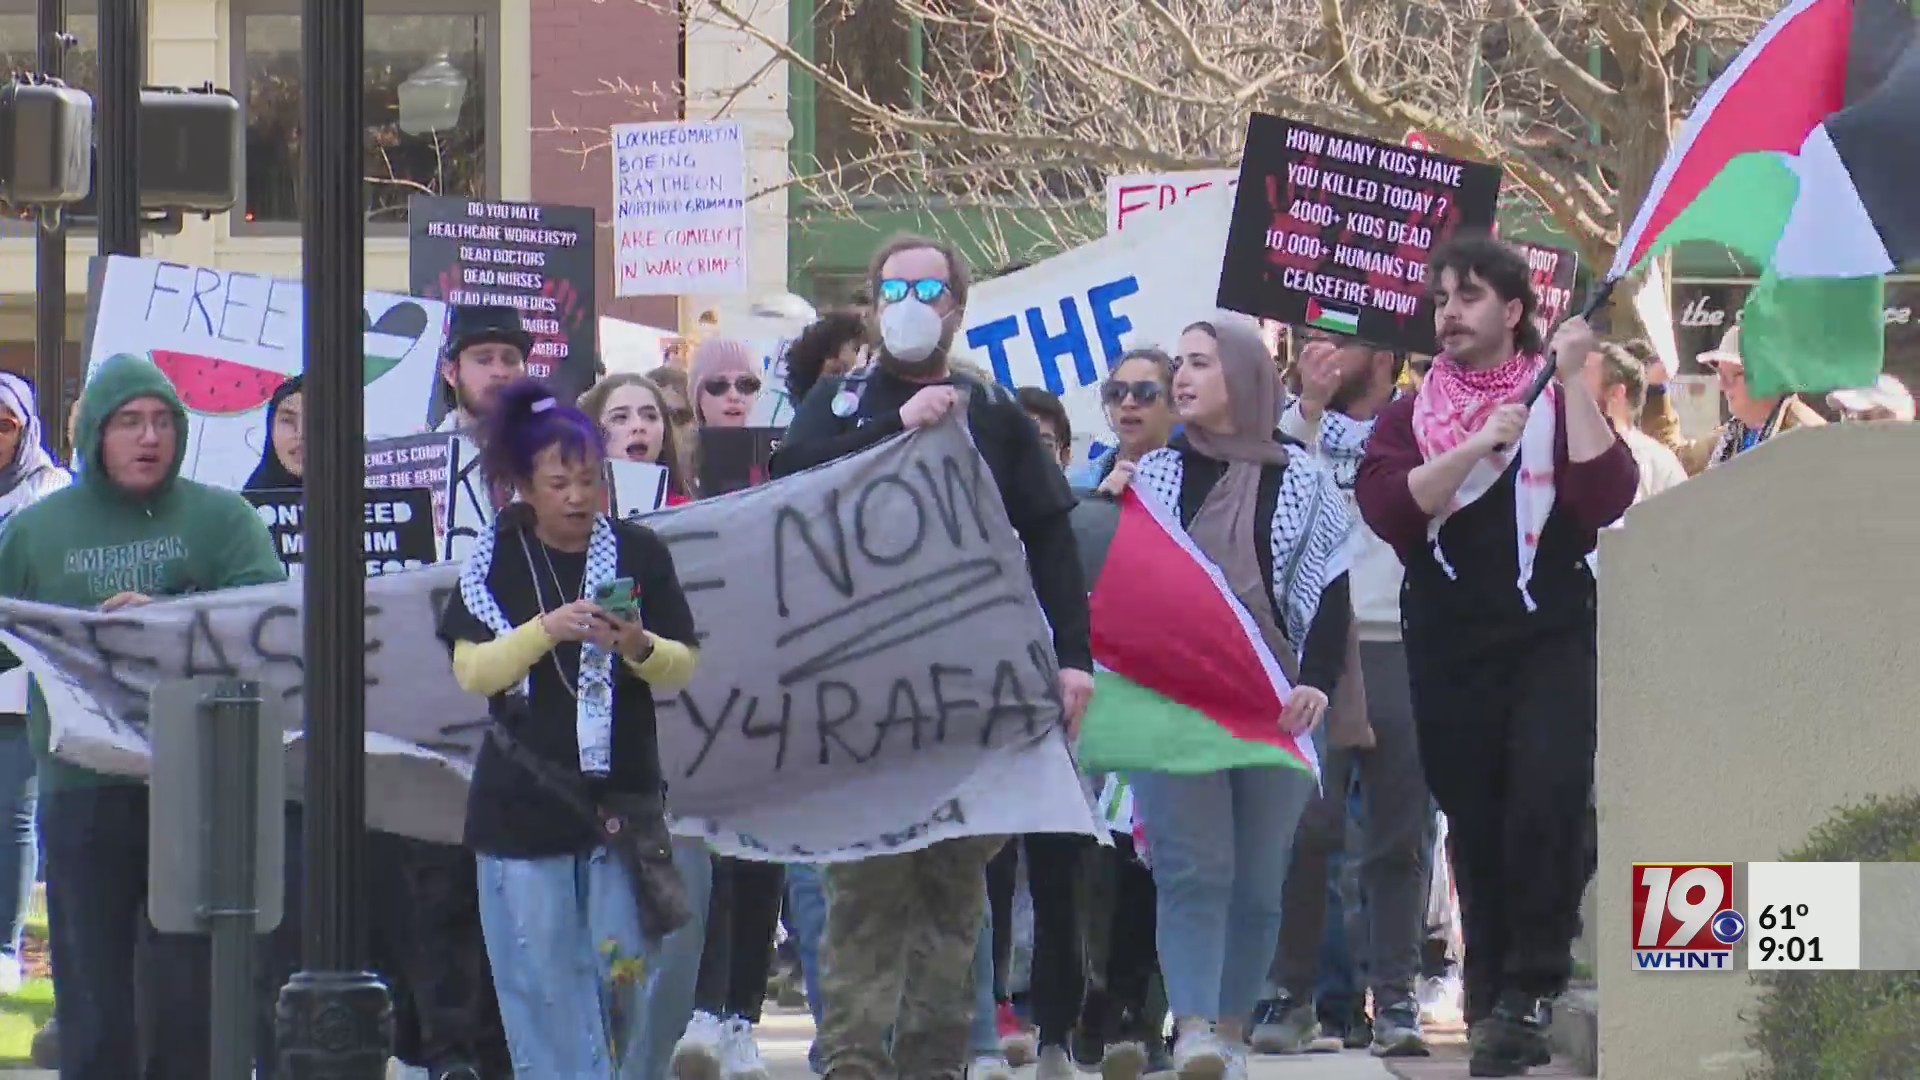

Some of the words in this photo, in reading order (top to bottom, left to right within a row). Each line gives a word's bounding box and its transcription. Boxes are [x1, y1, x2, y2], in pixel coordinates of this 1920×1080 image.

[619, 153, 696, 173] BOEING
[1286, 127, 1323, 155] HOW
[1327, 137, 1375, 166] MANY
[1379, 149, 1417, 174] KIDS
[1419, 158, 1464, 188] HAVE
[620, 174, 723, 196] RAYTHEON
[1288, 162, 1319, 187] YOU
[1321, 172, 1377, 202] KILLED
[1382, 184, 1433, 214] TODAY
[468, 201, 484, 217] DO
[486, 203, 510, 220] YOU
[511, 205, 542, 222] HATE
[429, 222, 502, 241] HEALTHCARE
[1289, 199, 1341, 227] 4000+
[1346, 213, 1384, 239] KIDS
[1387, 223, 1432, 249] DEAD
[621, 228, 657, 249] ARE
[665, 227, 743, 249] COMPLICIT
[460, 246, 491, 262] DEAD
[493, 249, 546, 267] DOCTORS
[1265, 229, 1330, 260] 10,000+
[1334, 244, 1405, 279] HUMANS
[1406, 261, 1429, 284] DE
[464, 268, 496, 285] DEAD
[497, 271, 543, 289] NURSES
[621, 262, 637, 283] IN
[646, 259, 683, 277] WAR
[450, 290, 481, 306] DEAD
[483, 294, 557, 312] PARAMEDICS
[1283, 267, 1368, 306] CEASEFIRE
[1372, 289, 1417, 317] NOW!
[144, 261, 304, 351] FREE
[1680, 296, 1725, 327] the
[966, 275, 1139, 398] THE
[364, 450, 395, 468] ENCE
[397, 448, 410, 464] IS
[411, 445, 448, 463] COMP
[364, 501, 412, 524] EED
[774, 452, 978, 618] NOW
[64, 535, 189, 575] AMERICAN
